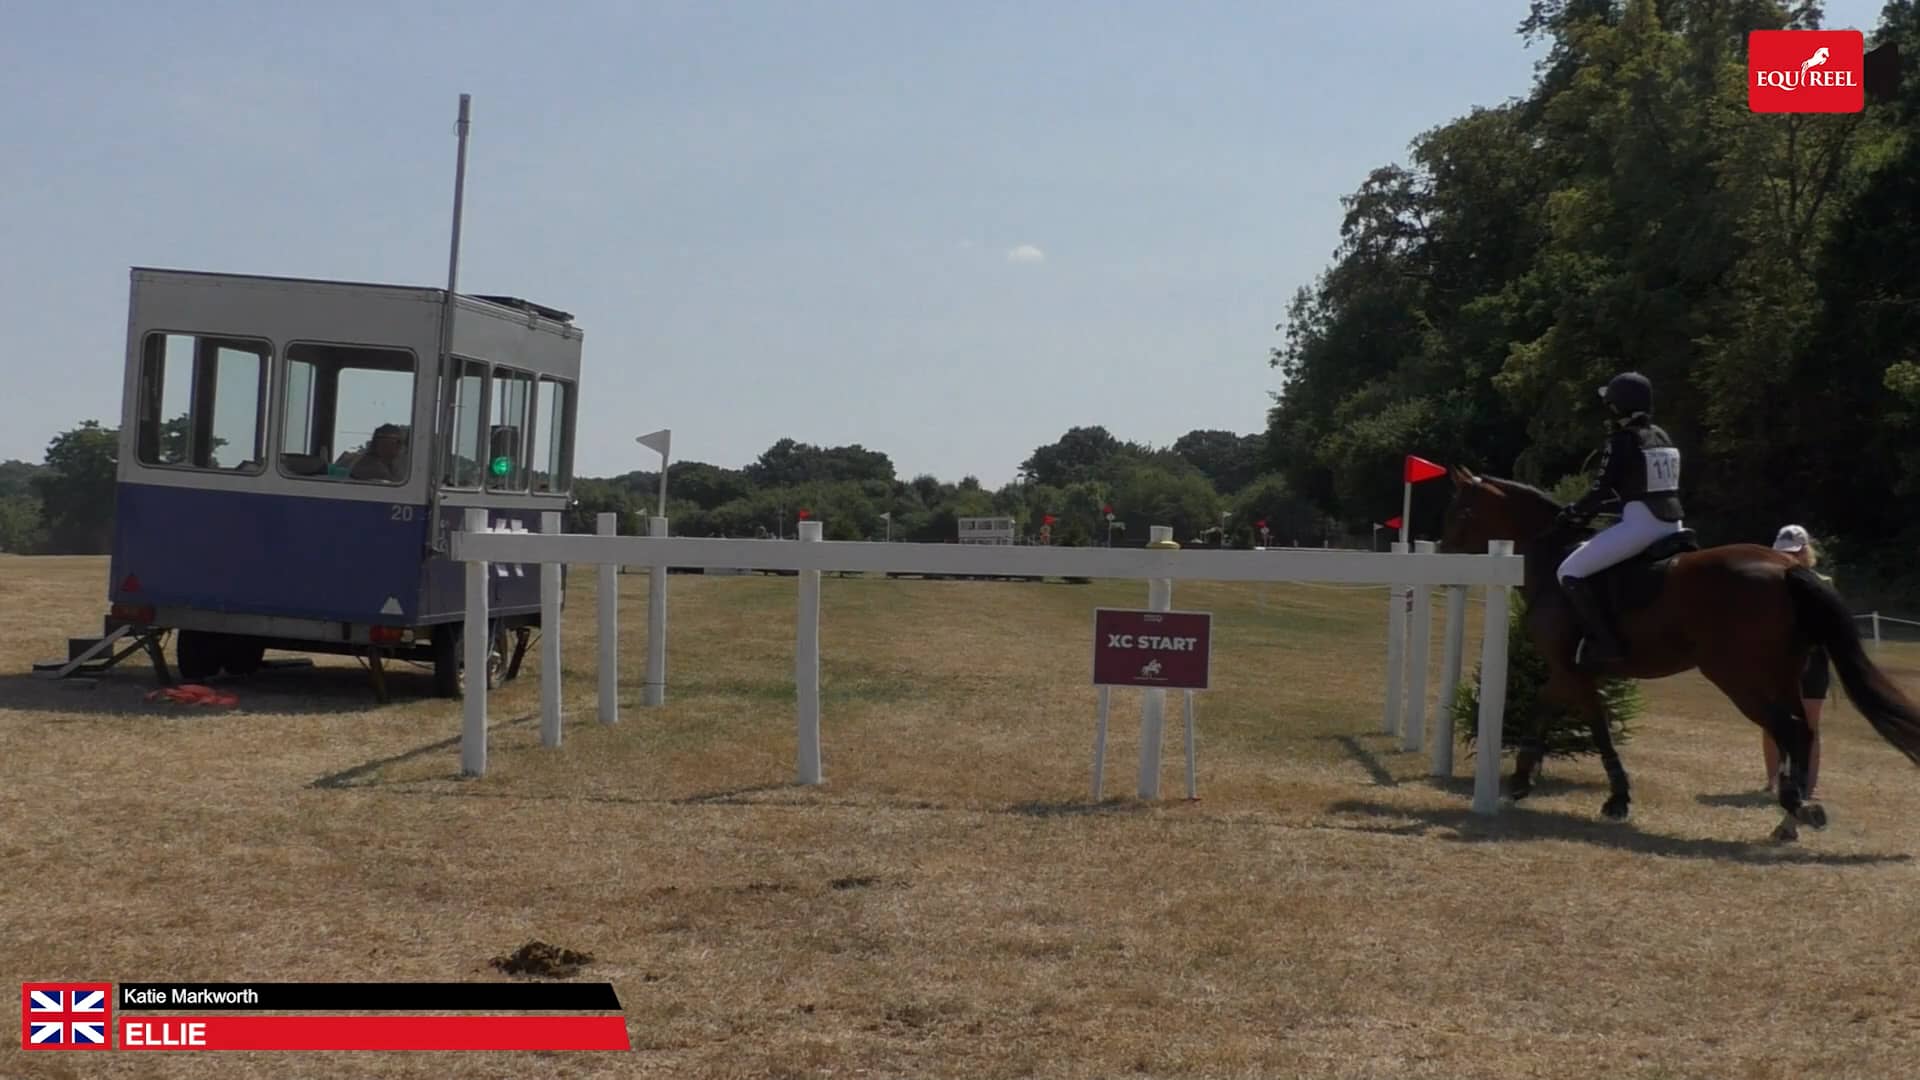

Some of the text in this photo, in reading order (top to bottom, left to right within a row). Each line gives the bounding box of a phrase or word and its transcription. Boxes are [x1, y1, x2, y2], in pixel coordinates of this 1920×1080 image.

[391, 505, 413, 522] 20
[1108, 634, 1197, 651] XC START
